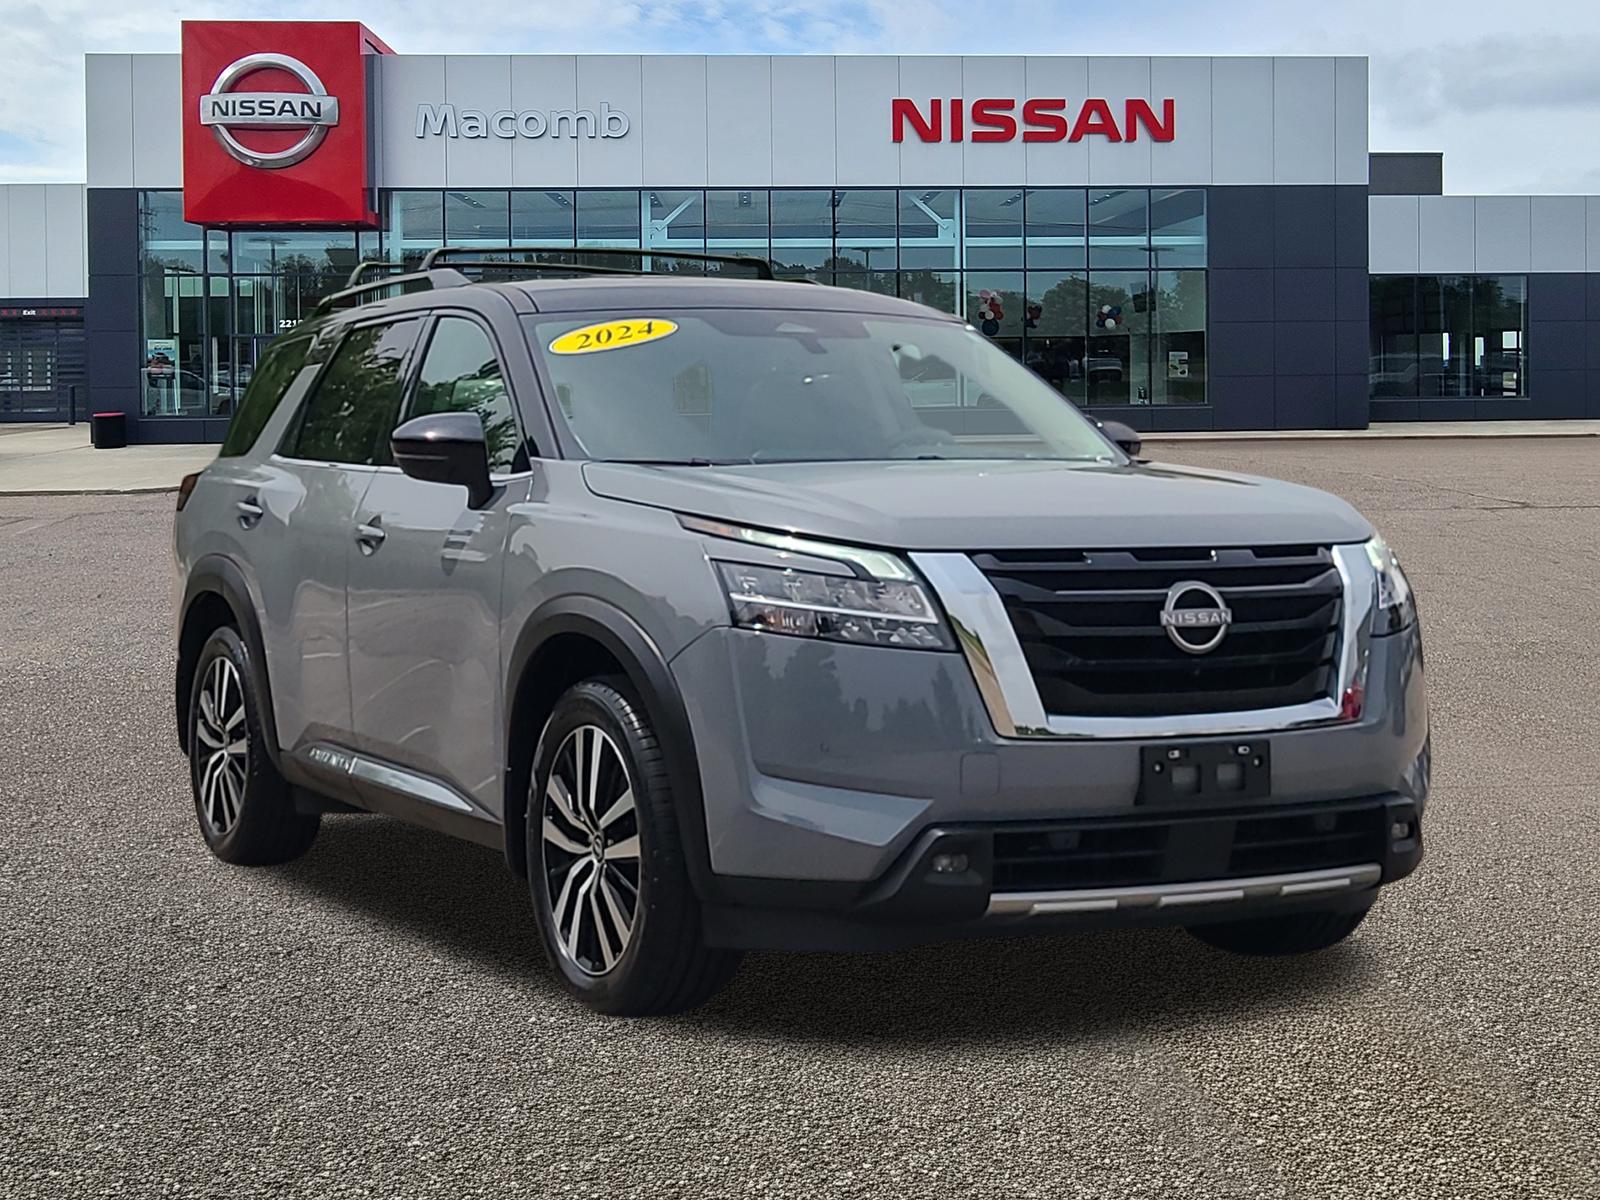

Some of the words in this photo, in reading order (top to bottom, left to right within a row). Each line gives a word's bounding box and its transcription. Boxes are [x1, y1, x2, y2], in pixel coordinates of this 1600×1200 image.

[211, 100, 322, 117] NISSAN
[415, 102, 630, 138] Macomb
[892, 98, 1175, 143] NISSAN
[576, 320, 654, 349] 2024
[1162, 611, 1231, 625] NISSAN
